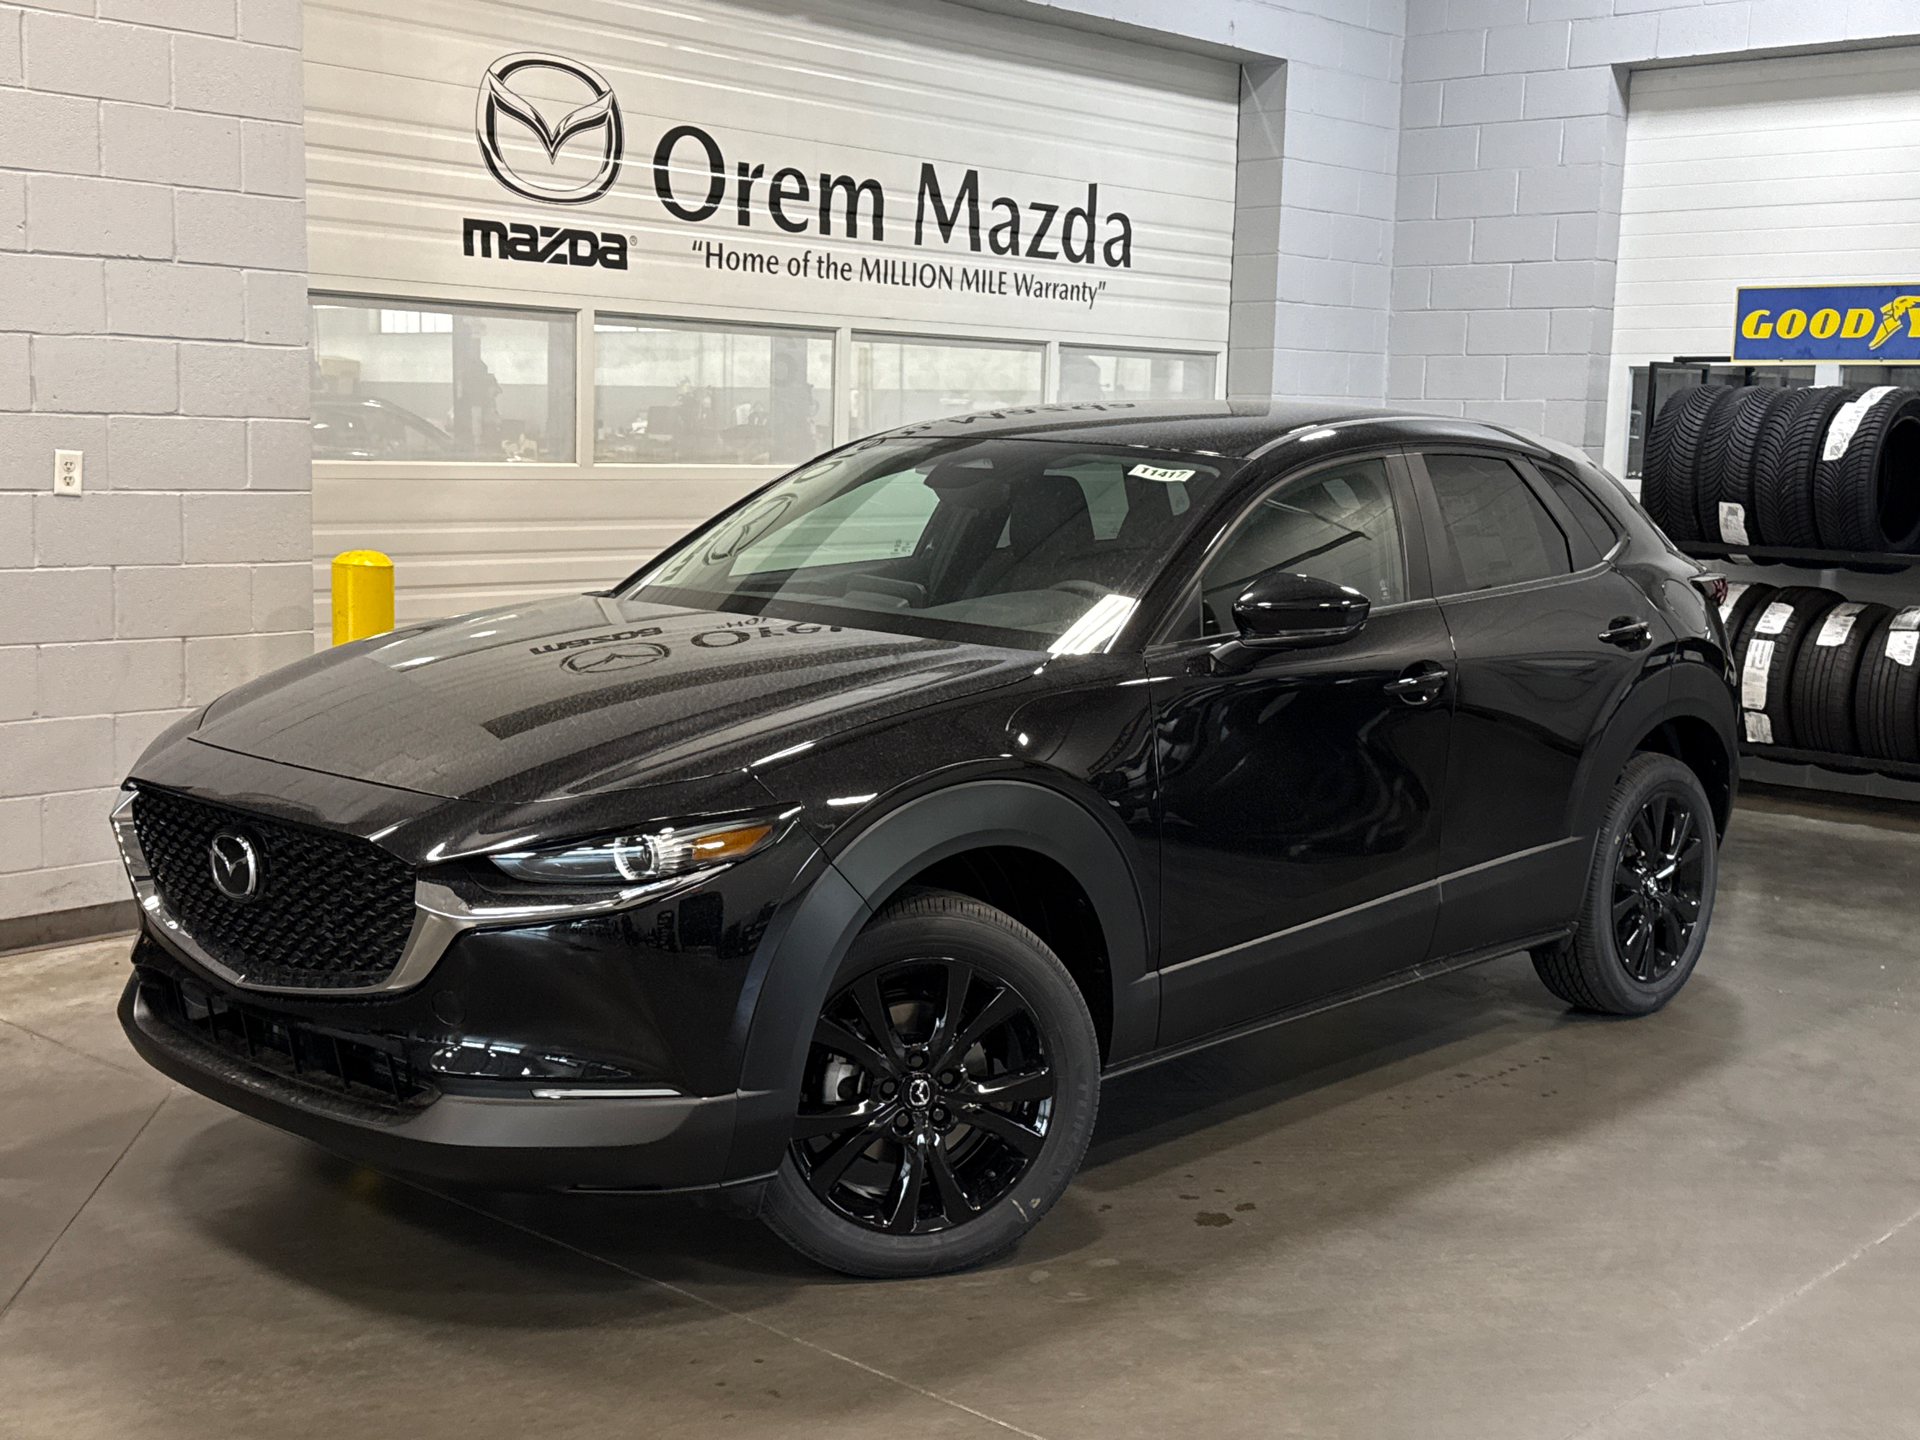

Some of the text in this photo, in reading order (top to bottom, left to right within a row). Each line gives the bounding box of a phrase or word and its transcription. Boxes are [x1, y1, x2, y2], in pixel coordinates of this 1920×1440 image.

[653, 125, 1132, 268] Orem Mazda
[692, 240, 1107, 310] “Home of the MILLION MILE Warranty”
[1141, 467, 1188, 478] 11417
